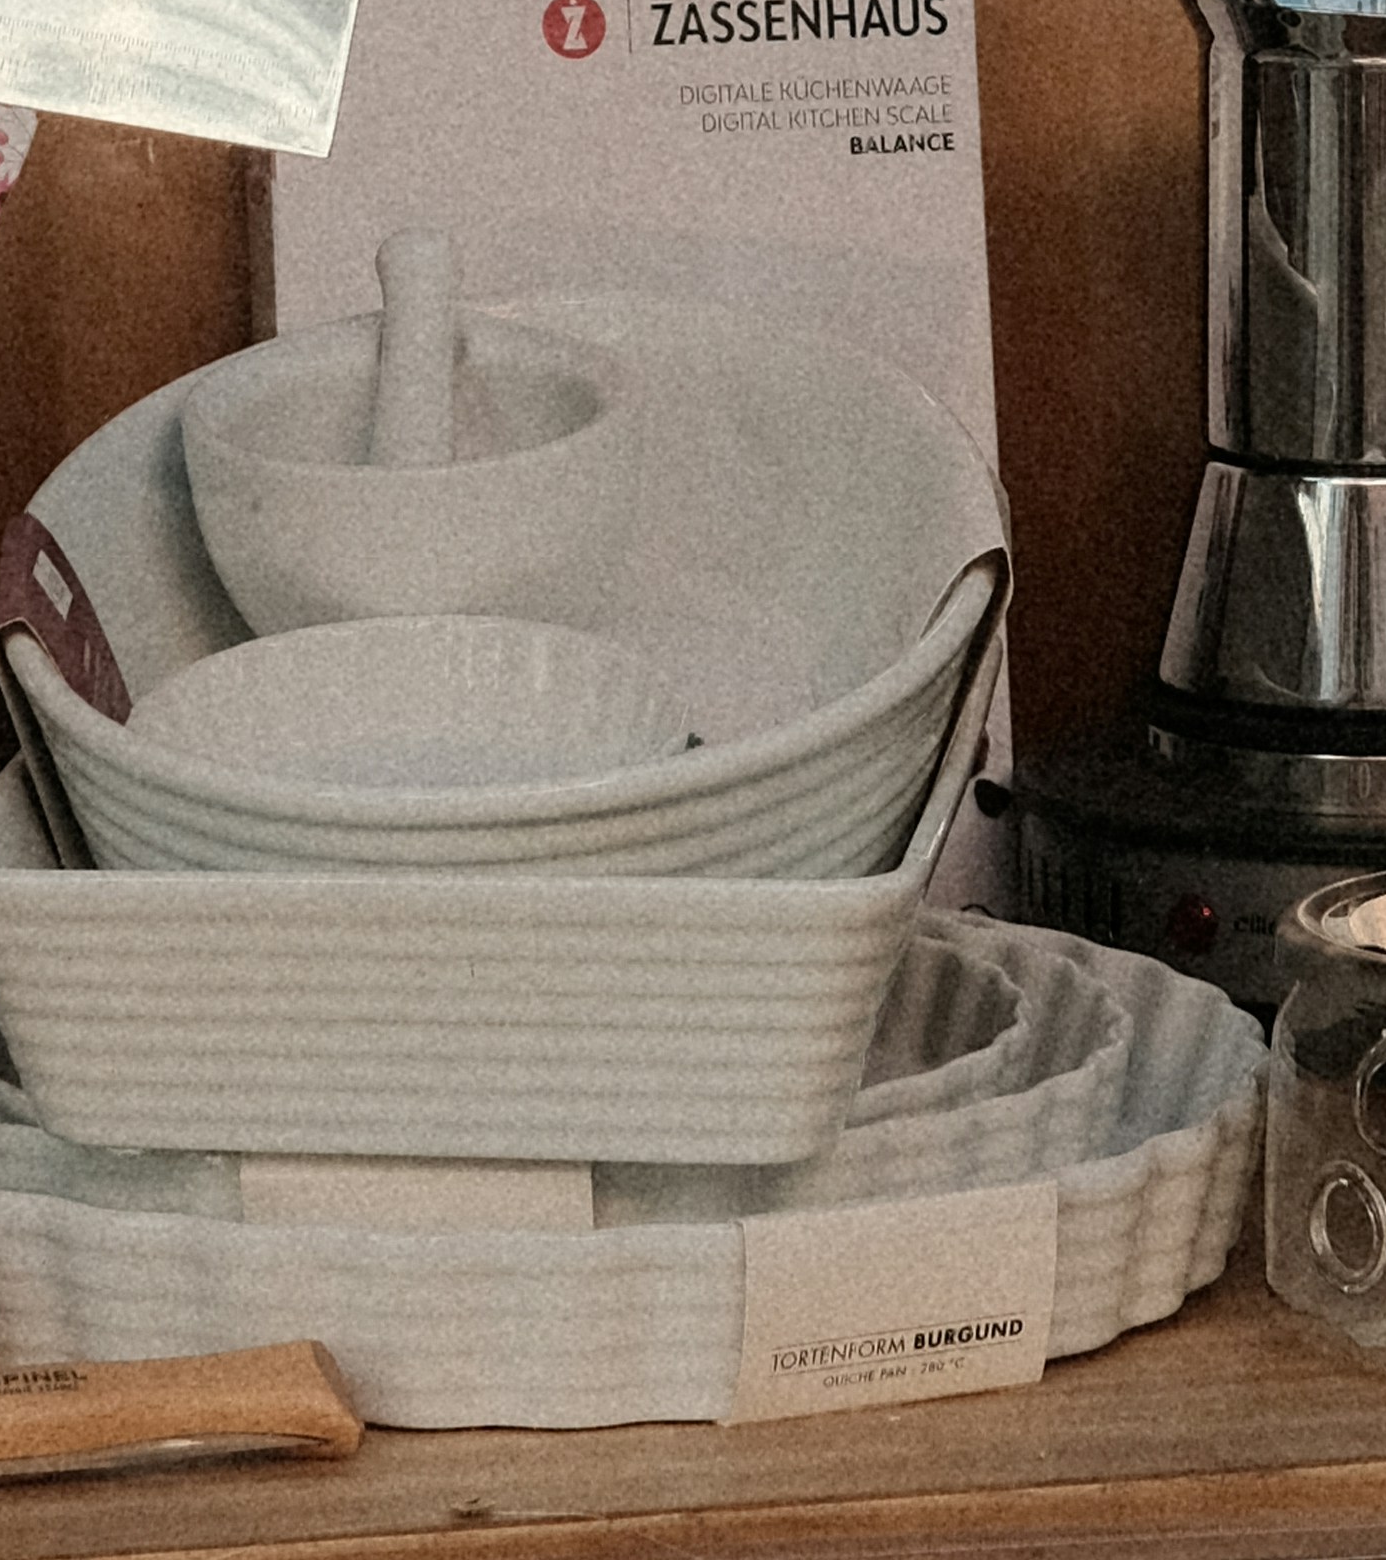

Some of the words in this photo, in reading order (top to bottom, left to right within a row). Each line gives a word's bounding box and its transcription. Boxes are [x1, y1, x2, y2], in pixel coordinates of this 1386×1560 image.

[679, 81, 773, 106] DIGITALE
[779, 74, 952, 103] KÜCHENWAAGE
[701, 110, 781, 134] DIGITAL
[788, 107, 880, 131] KITCHEN
[886, 103, 953, 126] SCALE
[849, 131, 955, 155] BALANCE
[771, 1335, 906, 1372] TORTENFORM
[913, 1318, 1023, 1350] BURGUND
[822, 1371, 875, 1389] QUICHE
[879, 1366, 907, 1380] PAN
